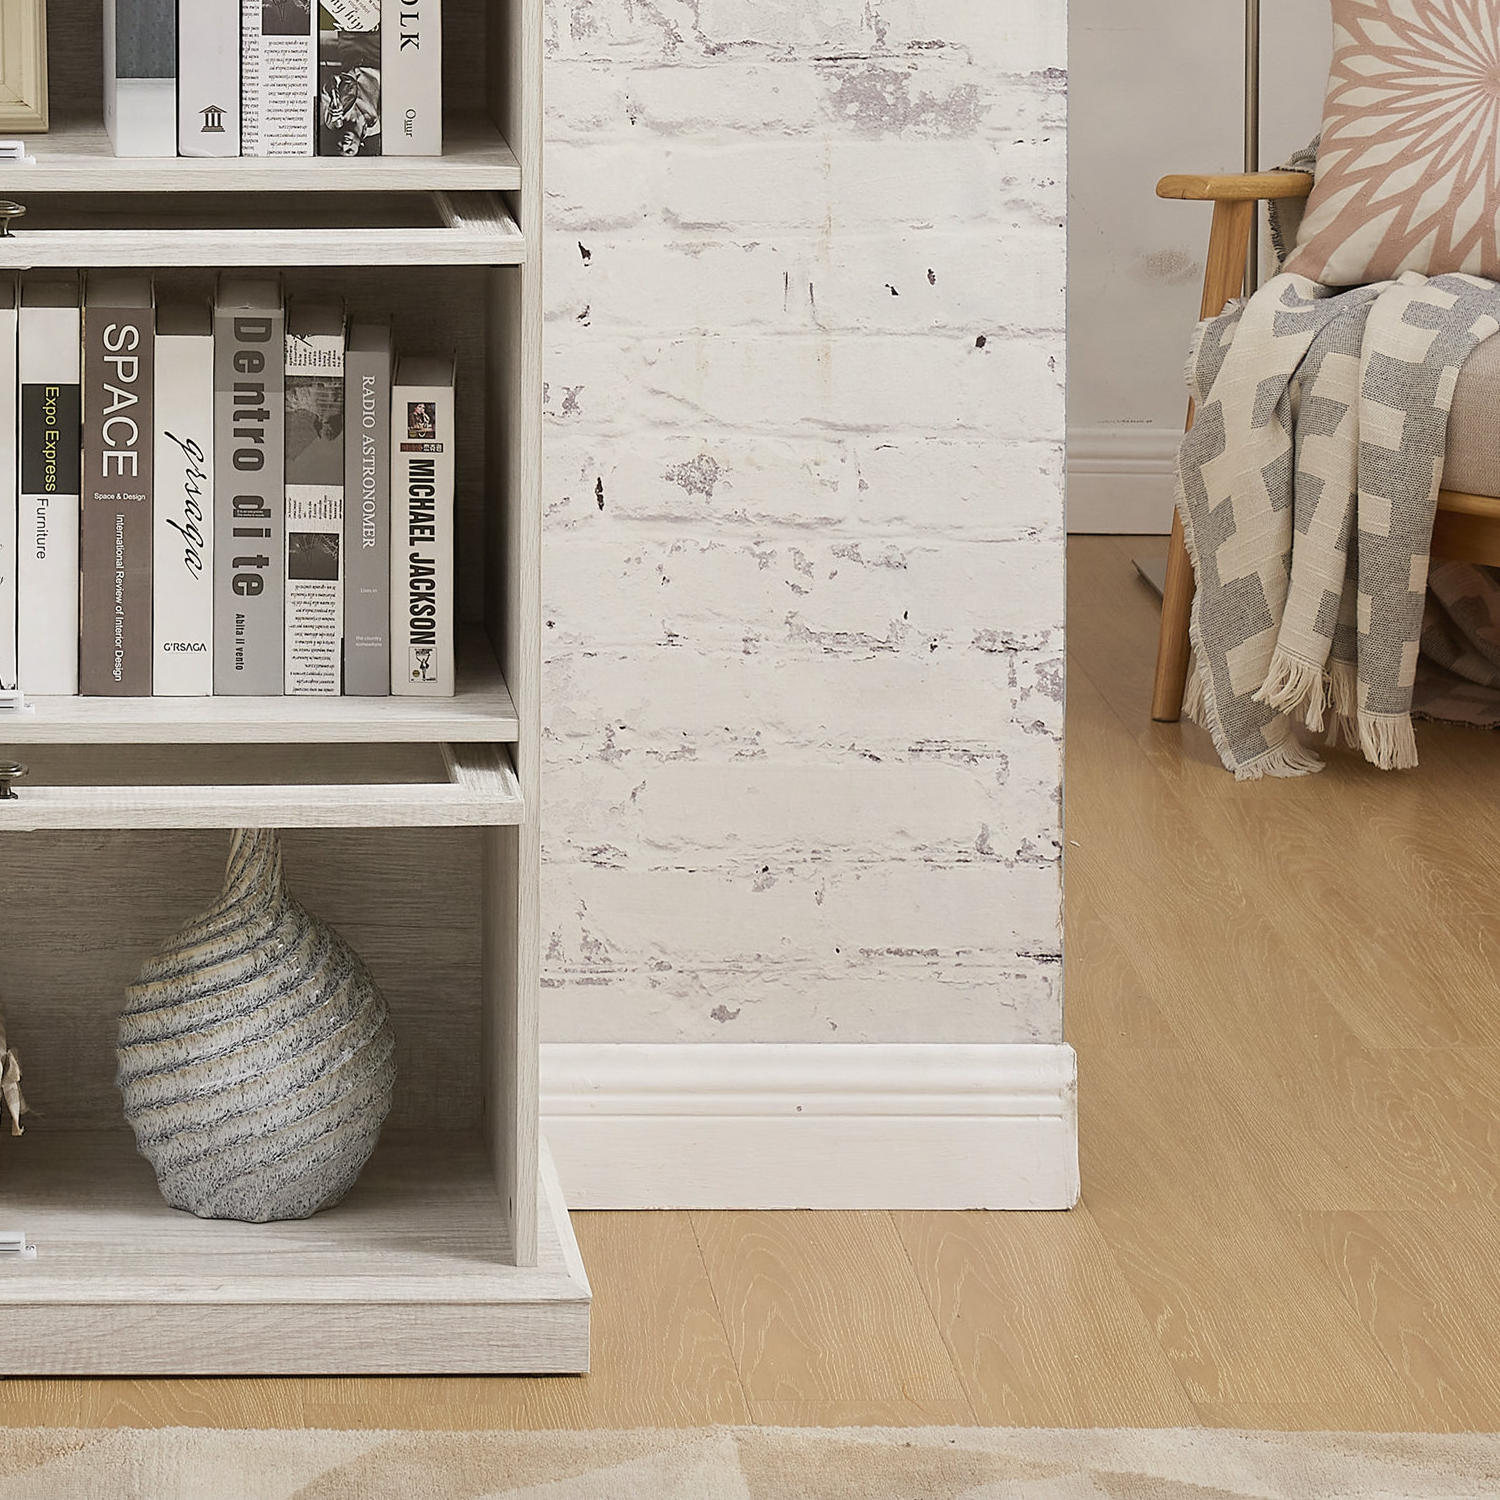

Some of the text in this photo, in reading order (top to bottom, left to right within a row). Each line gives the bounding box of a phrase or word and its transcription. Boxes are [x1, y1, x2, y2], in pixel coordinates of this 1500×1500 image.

[103, 324, 138, 476] SPACE
[232, 317, 272, 471] Dentro
[44, 386, 60, 492] Expo Express
[363, 376, 375, 548] RADIO ASTRONOMER
[36, 498, 49, 560] Furniture
[94, 493, 115, 501] Space
[123, 493, 146, 501] Design
[232, 495, 271, 538] di
[409, 459, 435, 546] MICHAEL
[113, 514, 125, 682] International Review of Interior Design
[231, 554, 270, 597] te
[409, 553, 435, 644] JACKSON
[235, 613, 245, 635] Abita
[235, 647, 244, 671] vento
